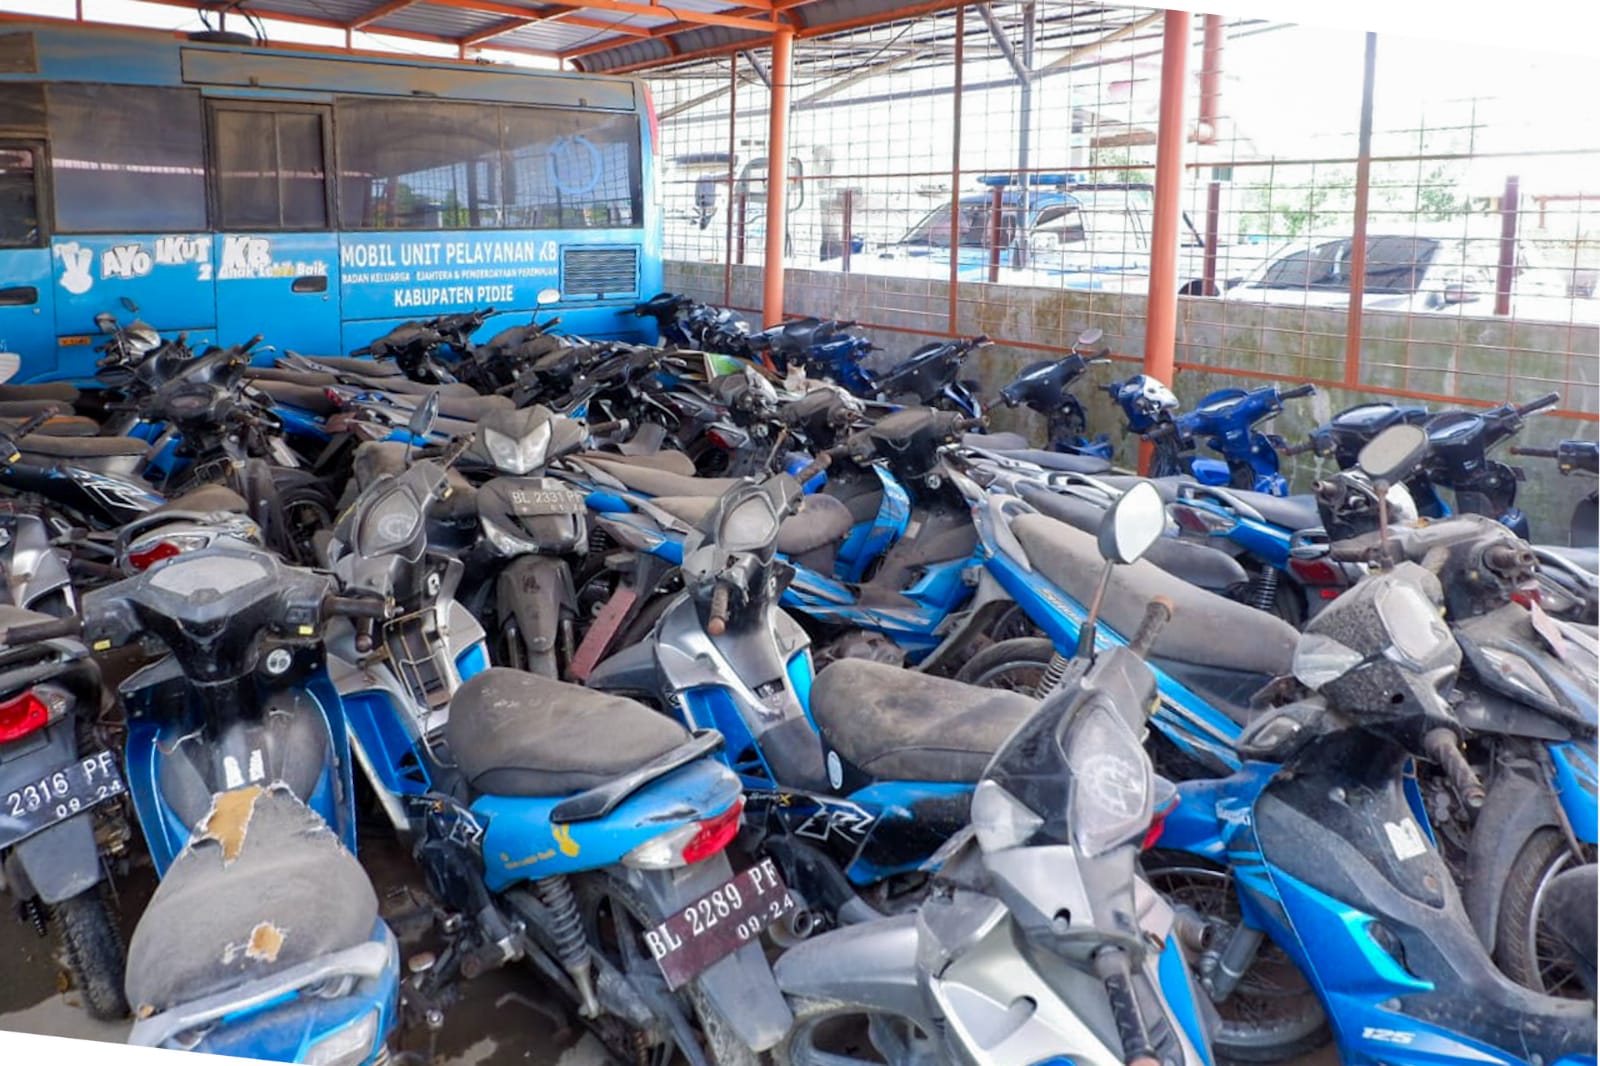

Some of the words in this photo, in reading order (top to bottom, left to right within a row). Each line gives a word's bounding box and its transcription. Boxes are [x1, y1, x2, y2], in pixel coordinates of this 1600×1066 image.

[102, 243, 152, 278] AYO
[155, 236, 212, 264] IKUT
[220, 233, 272, 268] KB
[341, 244, 396, 267] MOBIL
[401, 242, 441, 265] UNIT
[446, 241, 534, 264] PELAYANAN
[539, 240, 557, 262] KB
[197, 263, 213, 280] 2
[342, 273, 369, 284] BADAN
[370, 272, 410, 283] KELUARGA
[394, 286, 473, 307] KABUPATEN
[477, 284, 513, 303] PIDIE
[6, 772, 69, 816] 2316
[82, 750, 113, 785] PF
[646, 922, 682, 961] BL
[684, 882, 743, 936] 2289
[748, 857, 777, 896] PF
